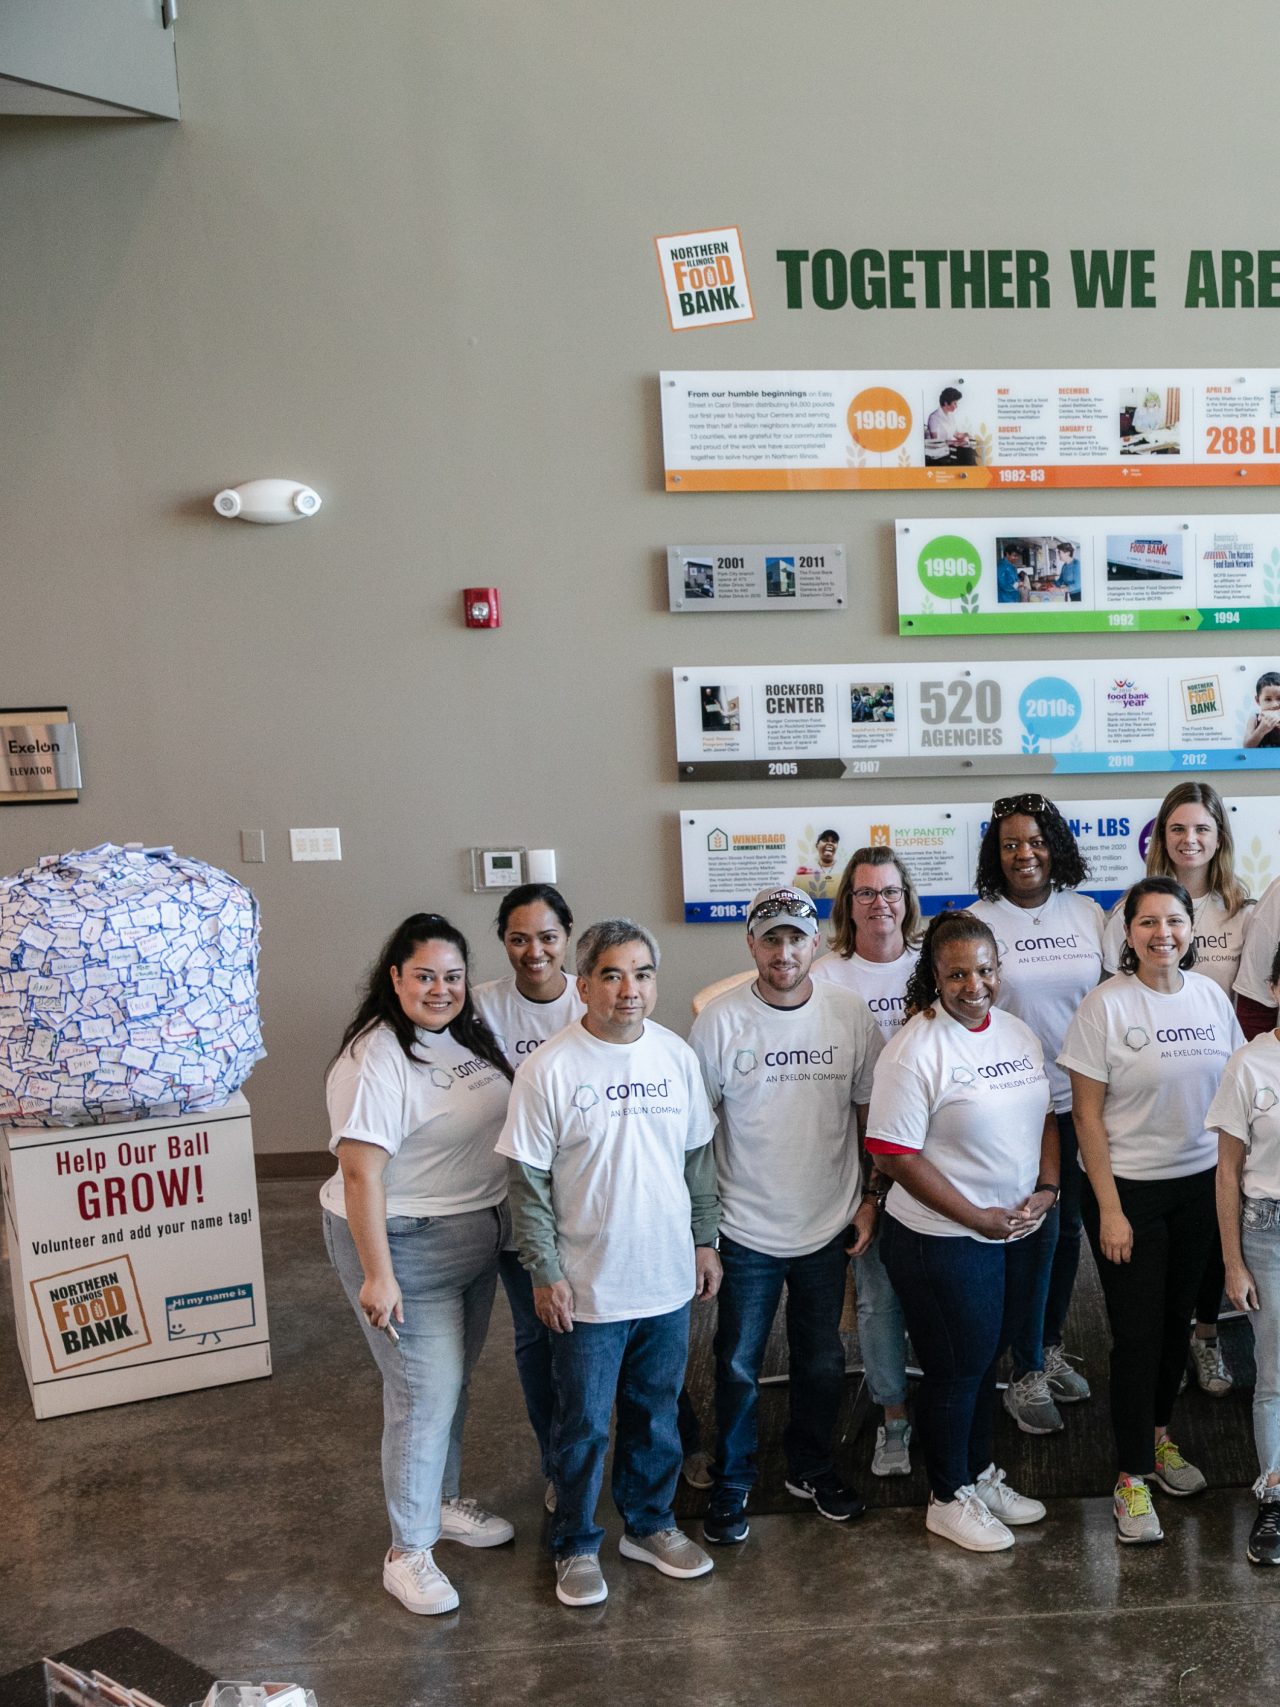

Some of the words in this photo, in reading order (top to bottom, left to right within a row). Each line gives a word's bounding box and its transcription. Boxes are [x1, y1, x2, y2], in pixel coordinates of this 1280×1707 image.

[670, 241, 729, 261] NORTHERN
[687, 256, 715, 267] ILLINOIS
[673, 255, 735, 292] FOOD
[776, 248, 1050, 310] TOGETHER
[1070, 249, 1157, 309] WE
[679, 286, 740, 316] BANK
[688, 390, 709, 398] From
[728, 390, 759, 398] humble
[761, 390, 807, 399] beginnings
[853, 410, 906, 430] 1980s
[1059, 425, 1084, 433] JANUARY
[1206, 426, 1255, 454] 288
[999, 469, 1045, 482] 1982-83
[1130, 543, 1146, 554] FOOD
[1147, 544, 1168, 555] BANK
[718, 557, 745, 569] 2001
[799, 556, 825, 568] 2011
[924, 558, 976, 577] 1990s
[1214, 611, 1240, 624] 1994
[766, 684, 824, 696] ROCKFORD
[1187, 682, 1213, 690] NORTHERN
[919, 679, 1002, 725] 520
[1107, 692, 1127, 700] food
[1128, 692, 1149, 700] bank
[766, 697, 825, 714] CENTER
[1026, 698, 1075, 718] 2010s
[1123, 699, 1146, 709] year
[1190, 701, 1217, 715] BANK
[921, 728, 1003, 748] AGENCIES
[8, 739, 60, 754] Exelon
[1108, 755, 1134, 767] 2010
[1182, 753, 1207, 765] 2012
[10, 767, 52, 776] ELEVATOR
[768, 762, 798, 775] 2005
[853, 761, 880, 773] 2007
[895, 829, 911, 837] MY
[913, 827, 956, 836] PANTRY
[1098, 817, 1130, 837] LBS
[732, 833, 785, 844] WINNEBAGO
[895, 837, 944, 847] EXPRESS
[1111, 843, 1127, 851] 2020
[770, 892, 799, 901] BEARS
[710, 904, 748, 918] 2018-1
[1015, 934, 1077, 951] comed
[1194, 932, 1227, 948] med
[1031, 954, 1061, 963] EXELON
[868, 997, 905, 1013] com
[1156, 1023, 1216, 1043] comed
[765, 1045, 833, 1066] comed
[1173, 1048, 1202, 1057] EXELON
[977, 1054, 1034, 1078] comed
[780, 1073, 810, 1081] EXELON
[812, 1073, 848, 1081] COMPANY
[606, 1078, 668, 1101] comed
[1000, 1079, 1026, 1090] EXELON
[56, 1148, 106, 1175] Help
[118, 1142, 157, 1166] Our
[167, 1131, 209, 1160] Ball
[77, 1164, 204, 1221] GROW!
[32, 1234, 95, 1255] Volunteer
[102, 1228, 124, 1244] and
[130, 1224, 151, 1241] add
[157, 1220, 185, 1238] your
[191, 1214, 223, 1231] name
[228, 1208, 252, 1227] tag!
[49, 1271, 119, 1302] NORTHERN
[69, 1289, 103, 1306] ILLINOIS
[172, 1298, 185, 1308] Hi
[187, 1296, 203, 1307] my
[206, 1290, 233, 1302] name
[236, 1288, 247, 1298] is
[52, 1285, 128, 1332] FOOD
[61, 1313, 134, 1355] BANK
